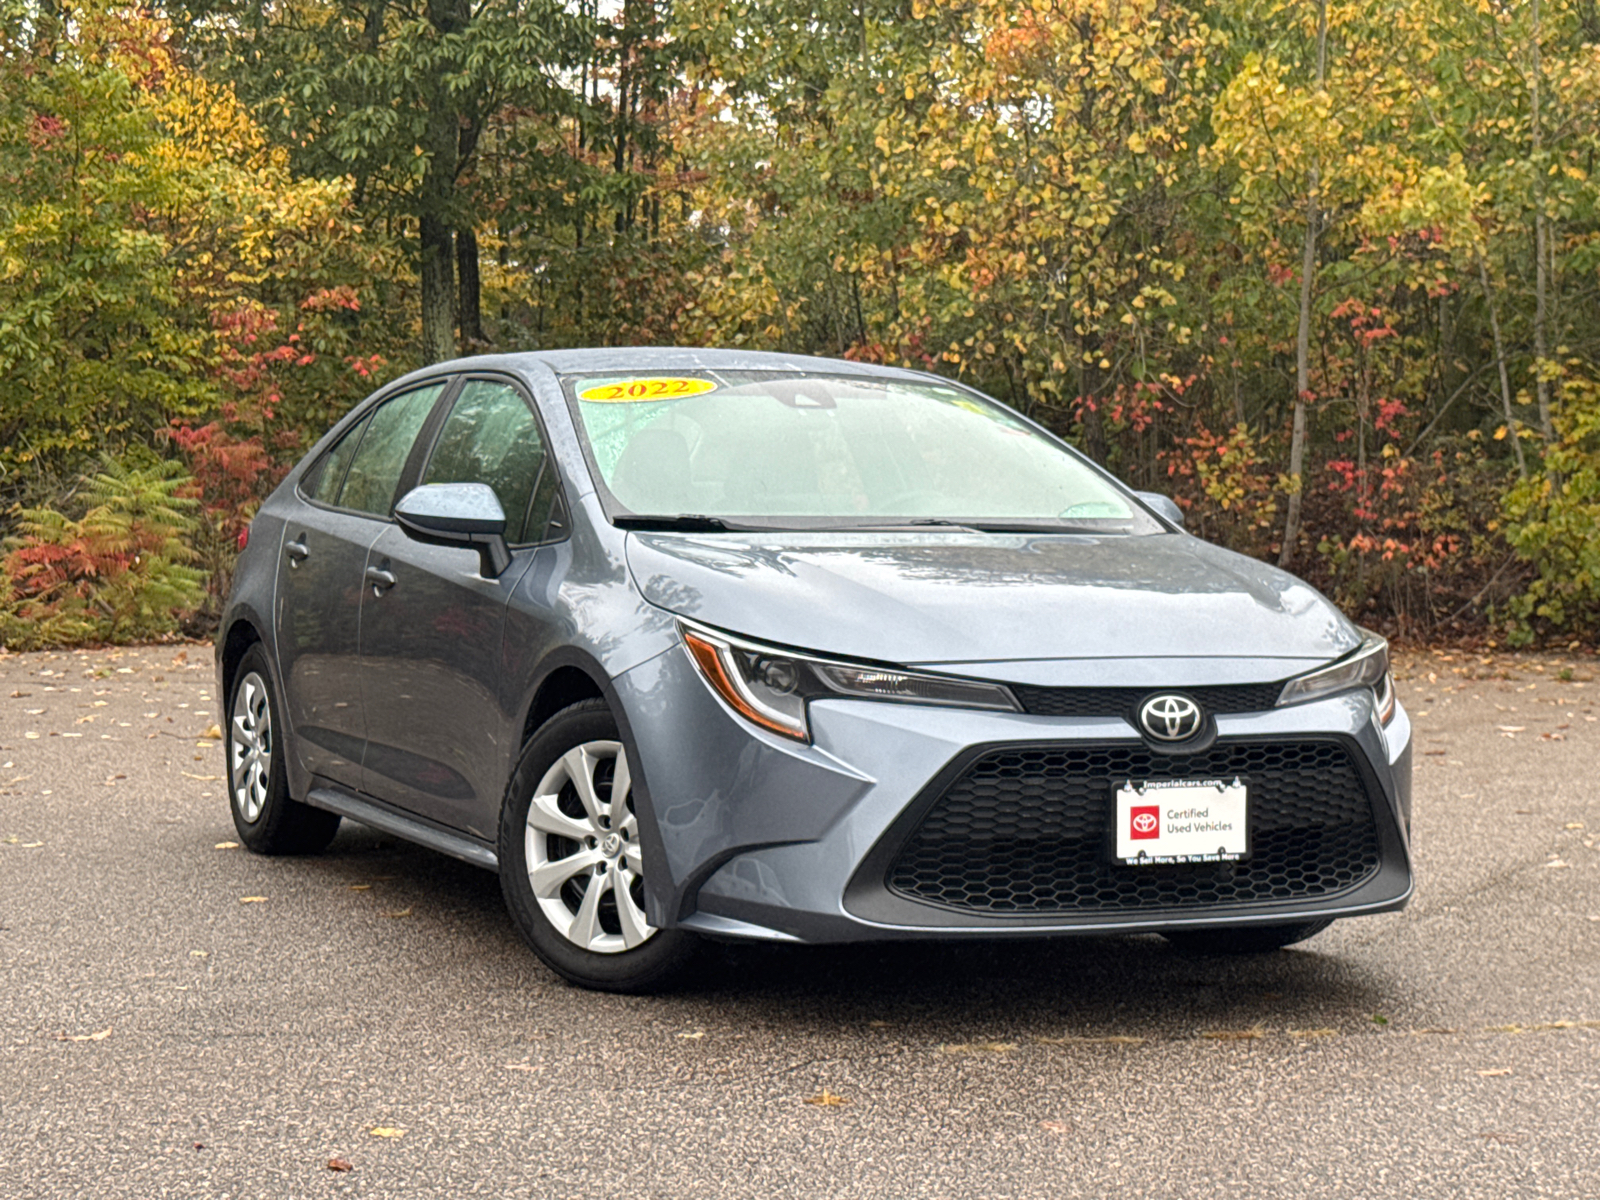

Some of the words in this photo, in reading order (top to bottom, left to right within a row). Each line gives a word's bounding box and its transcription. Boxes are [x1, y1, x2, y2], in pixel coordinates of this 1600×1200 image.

[607, 380, 690, 399] 2022
[1167, 808, 1209, 819] Certified
[1167, 823, 1191, 833] Used
[1194, 821, 1233, 832] Vehicles
[1188, 855, 1202, 863] You
[1203, 854, 1220, 862] Save
